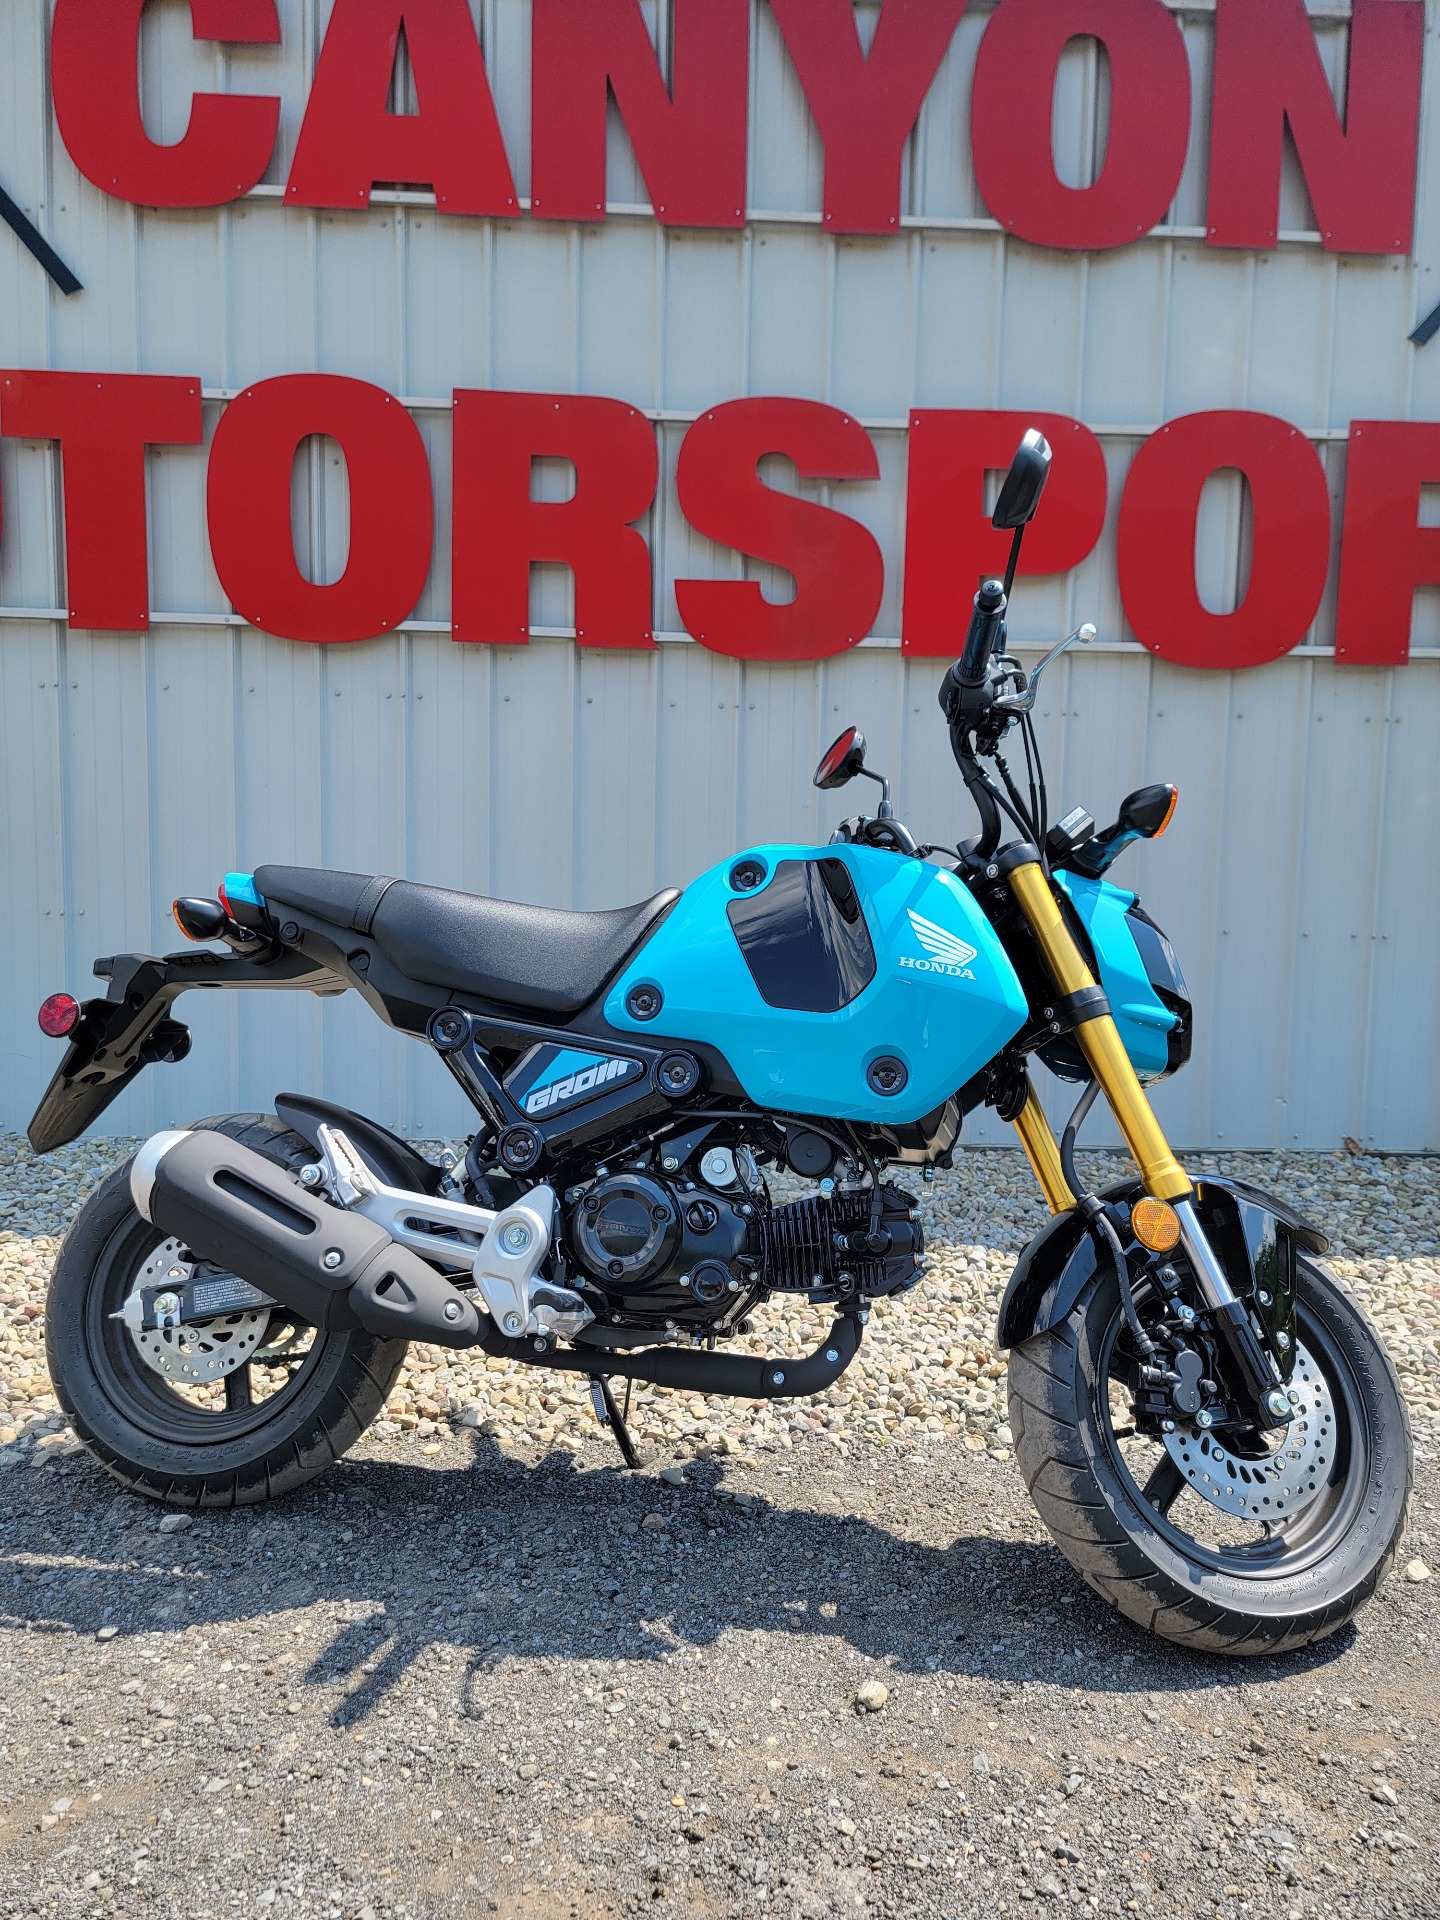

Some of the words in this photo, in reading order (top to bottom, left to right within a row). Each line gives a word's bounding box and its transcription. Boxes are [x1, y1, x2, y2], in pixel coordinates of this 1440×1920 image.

[51, 0, 1424, 255] CANYON
[898, 956, 977, 981] HONDA
[526, 1060, 628, 1114] GROM
